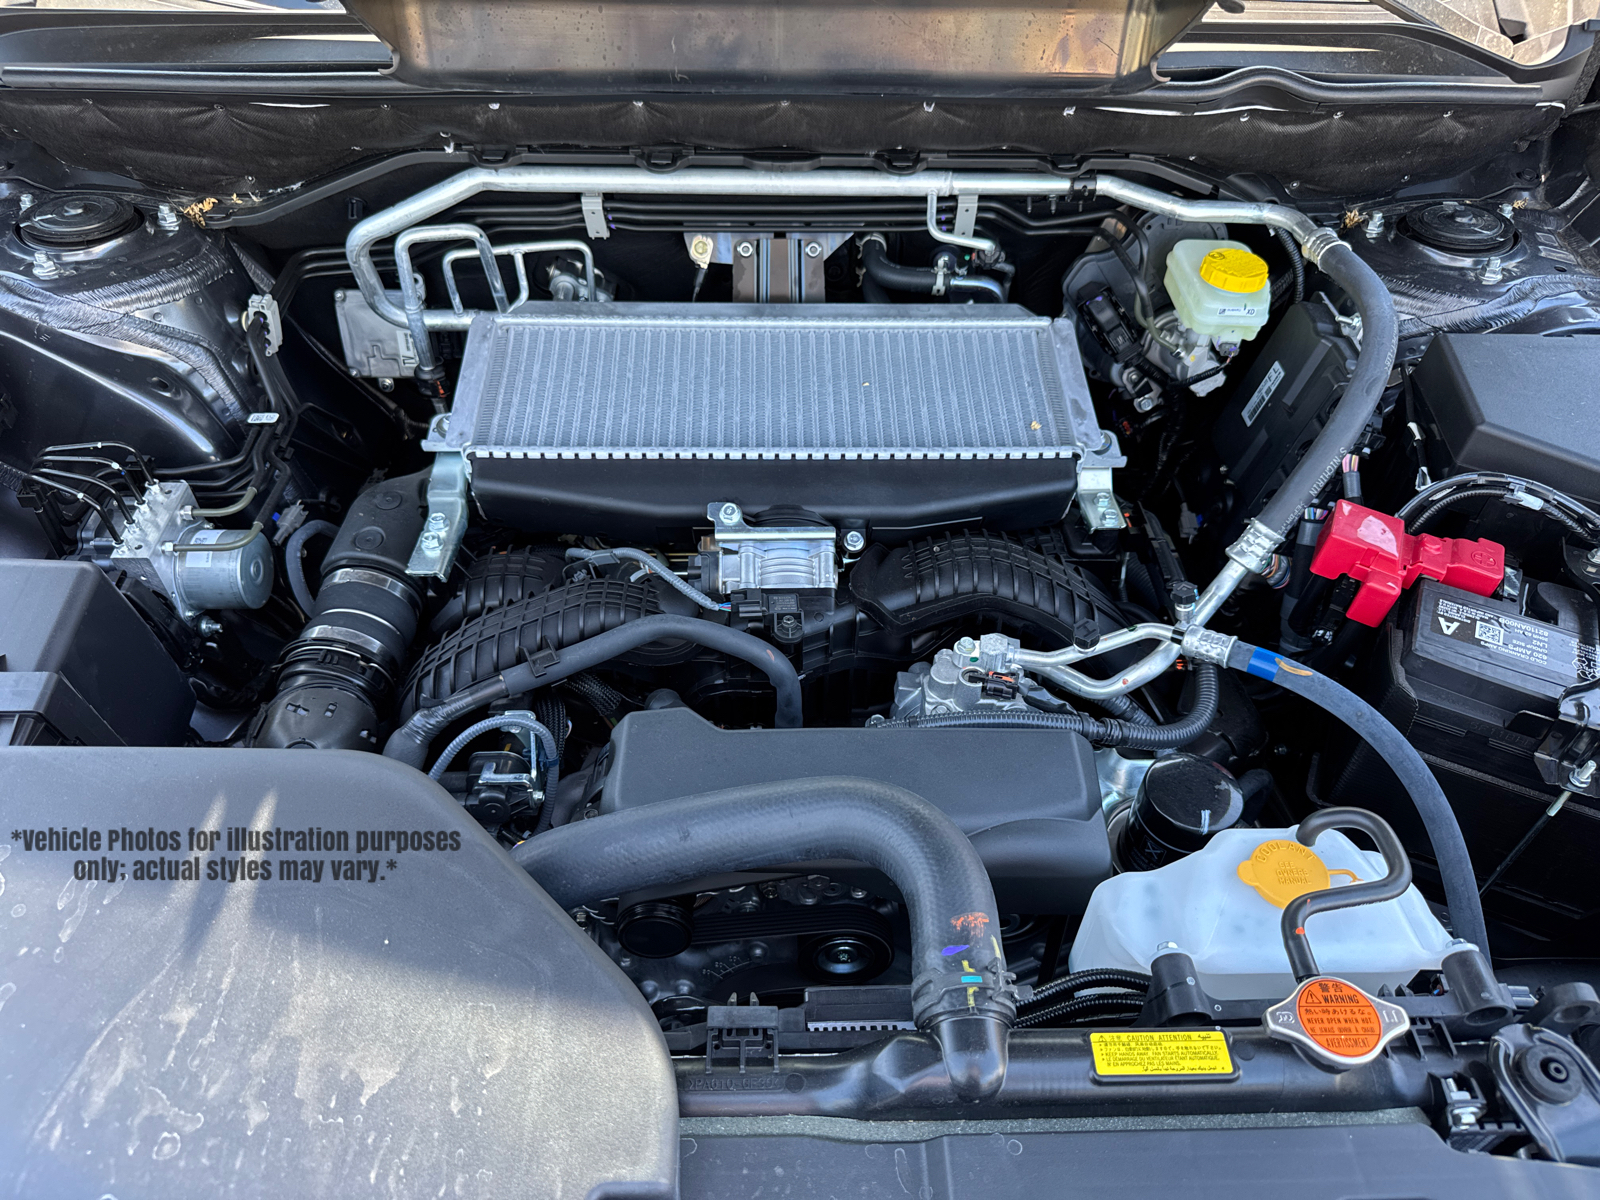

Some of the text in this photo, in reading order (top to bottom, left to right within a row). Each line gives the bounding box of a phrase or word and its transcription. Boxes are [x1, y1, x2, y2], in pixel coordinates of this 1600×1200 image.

[1438, 617, 1460, 635] A
[1526, 645, 1547, 653] GROUP
[1532, 640, 1548, 648] LN2
[1498, 647, 1529, 659] CRANKING
[1508, 644, 1547, 660] 620 AMPS
[1530, 657, 1547, 665] COLD
[1256, 842, 1316, 863] COOLANT
[1279, 861, 1295, 869] SEE
[1278, 877, 1312, 885] MANUAL
[1318, 983, 1343, 993] 警告
[1321, 994, 1359, 1004] WARNING
